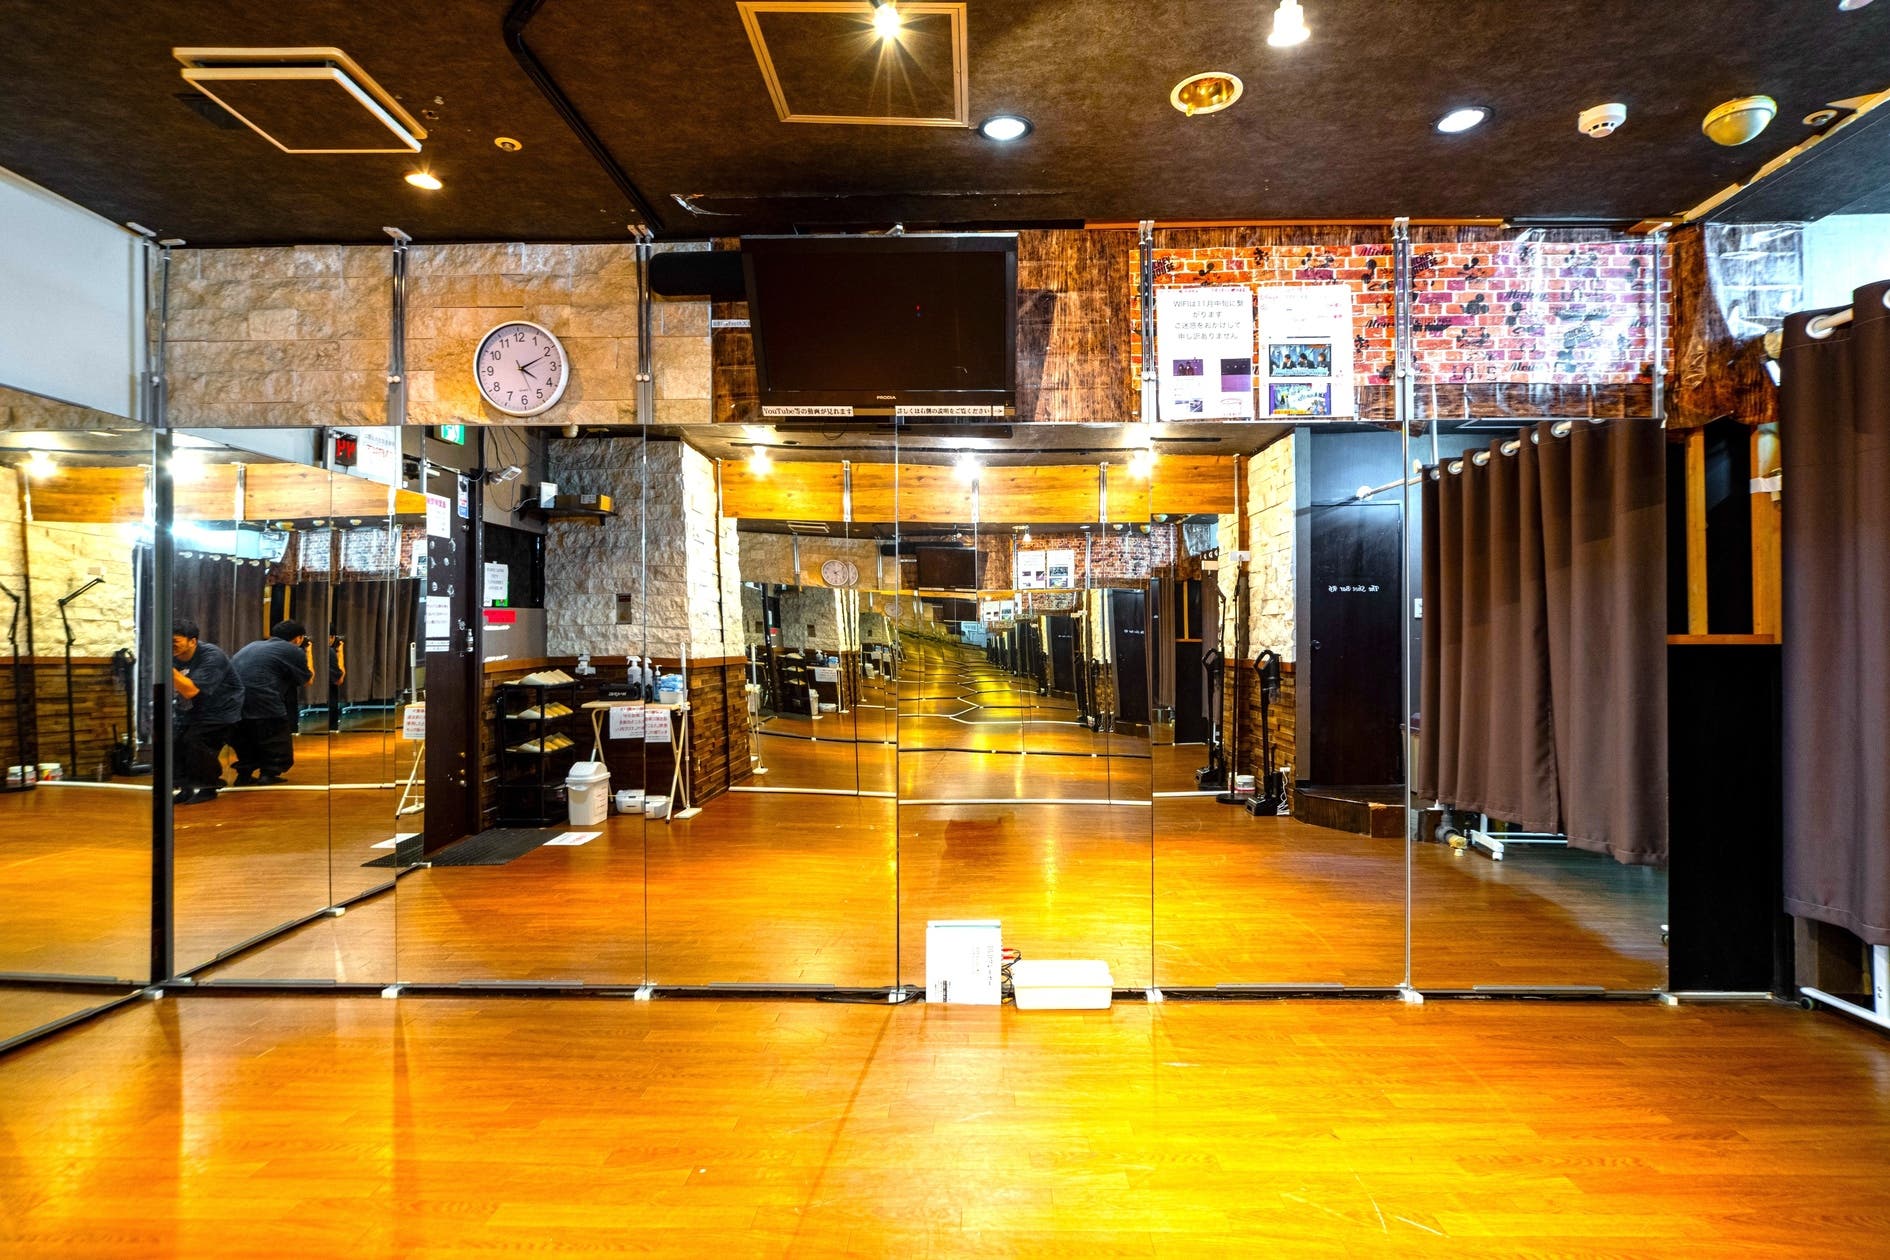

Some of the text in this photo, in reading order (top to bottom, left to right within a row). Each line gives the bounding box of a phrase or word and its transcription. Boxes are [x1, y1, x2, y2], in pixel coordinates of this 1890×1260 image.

[1192, 311, 1222, 319] がります
[513, 332, 525, 342] 12
[532, 336, 538, 346] 1
[1178, 332, 1238, 341] 申し訳ありません
[500, 339, 510, 348] 11
[490, 350, 501, 361] 10
[543, 346, 551, 357] 2
[486, 366, 494, 376] 9
[549, 361, 557, 372] 3
[493, 382, 501, 392] 8
[545, 377, 553, 387] 4
[506, 391, 513, 401] 7
[536, 389, 543, 398] 5
[521, 395, 528, 405] 6
[763, 407, 852, 416] YouTube等の動画が見れます
